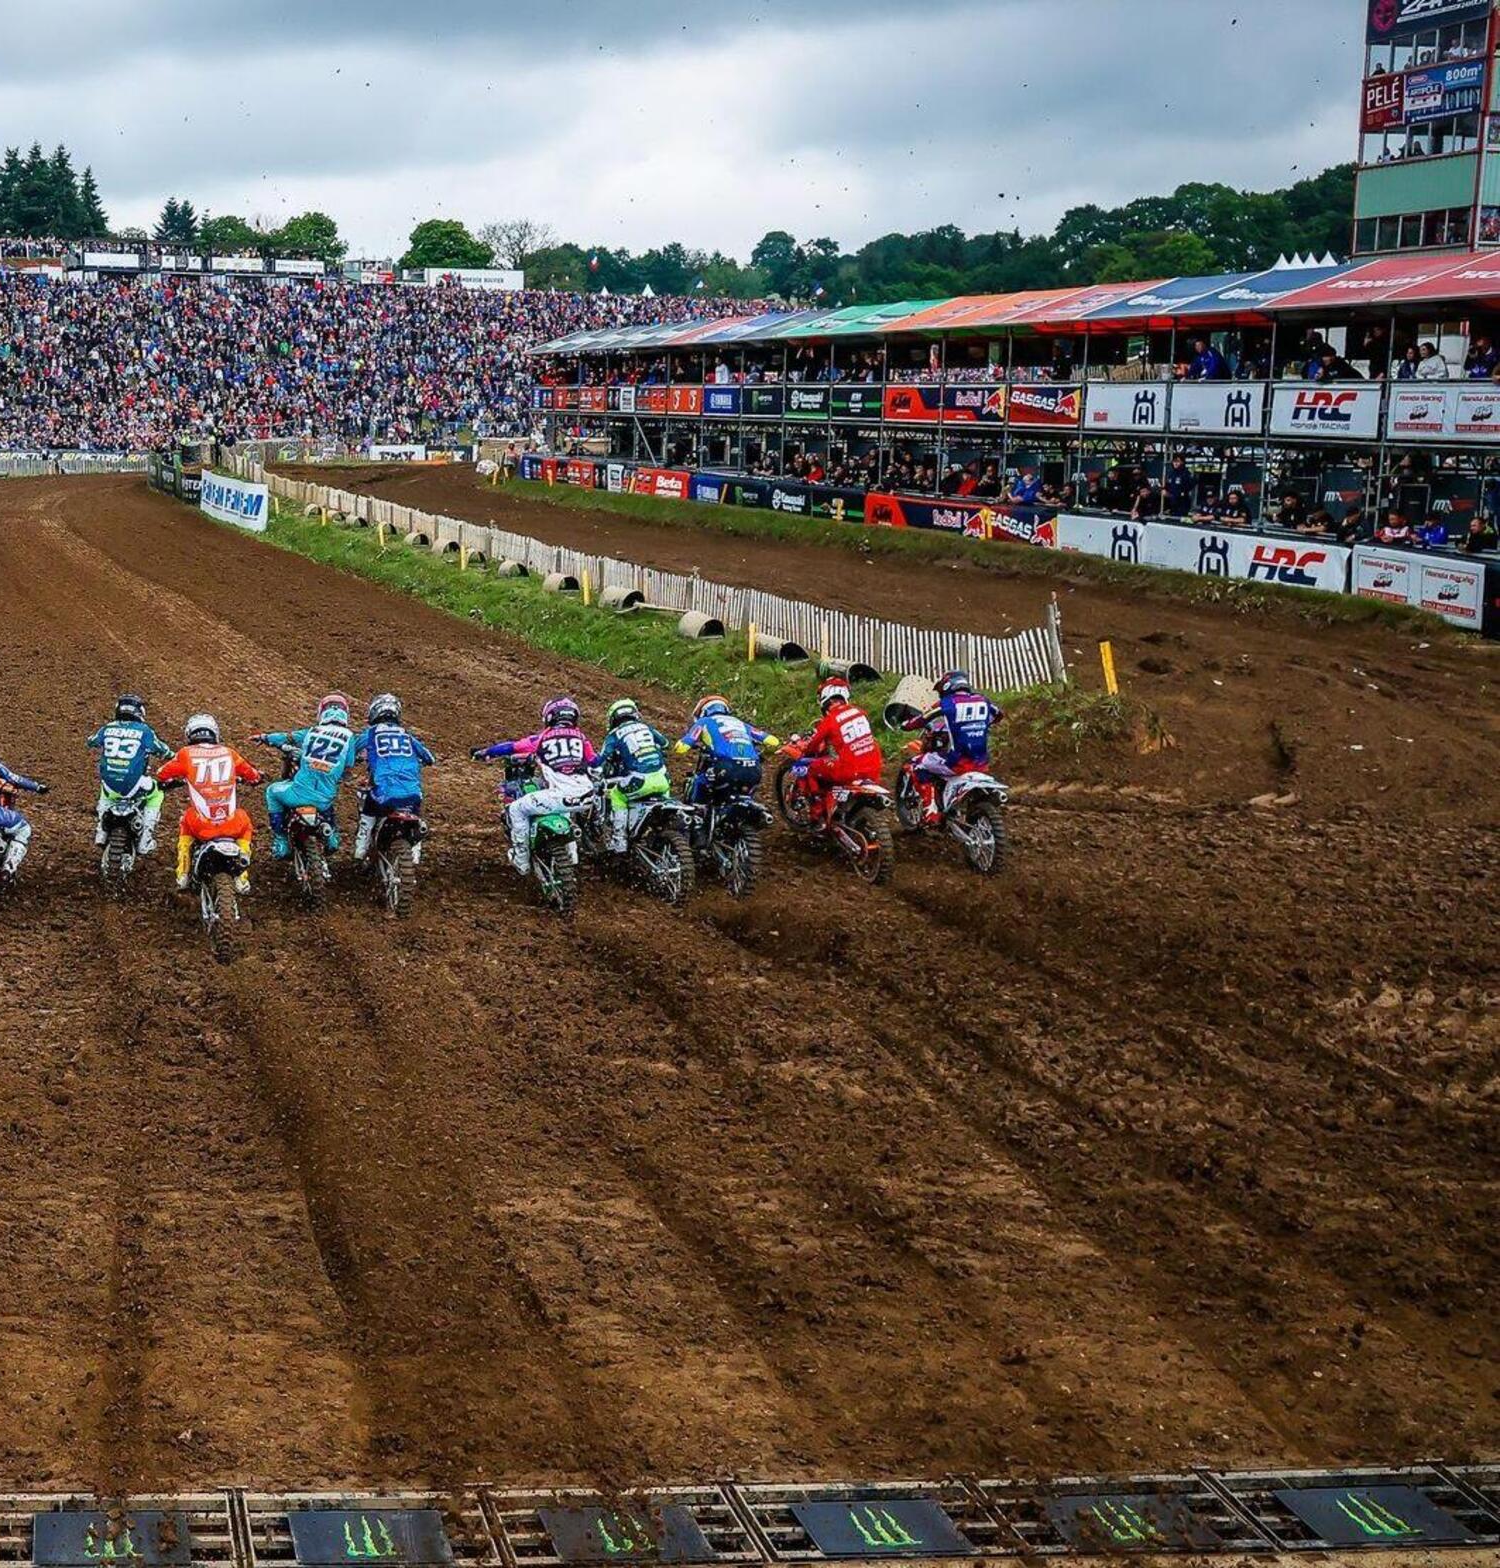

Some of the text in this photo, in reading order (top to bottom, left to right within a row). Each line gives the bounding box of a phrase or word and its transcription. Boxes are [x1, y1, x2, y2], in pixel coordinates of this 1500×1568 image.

[1367, 76, 1399, 109] PELÉ
[1011, 390, 1056, 411] GASGAS
[1291, 391, 1358, 422] HRC
[656, 475, 683, 490] Beta
[1248, 545, 1327, 586] HRC
[305, 735, 344, 764] 122
[542, 738, 584, 761] 319
